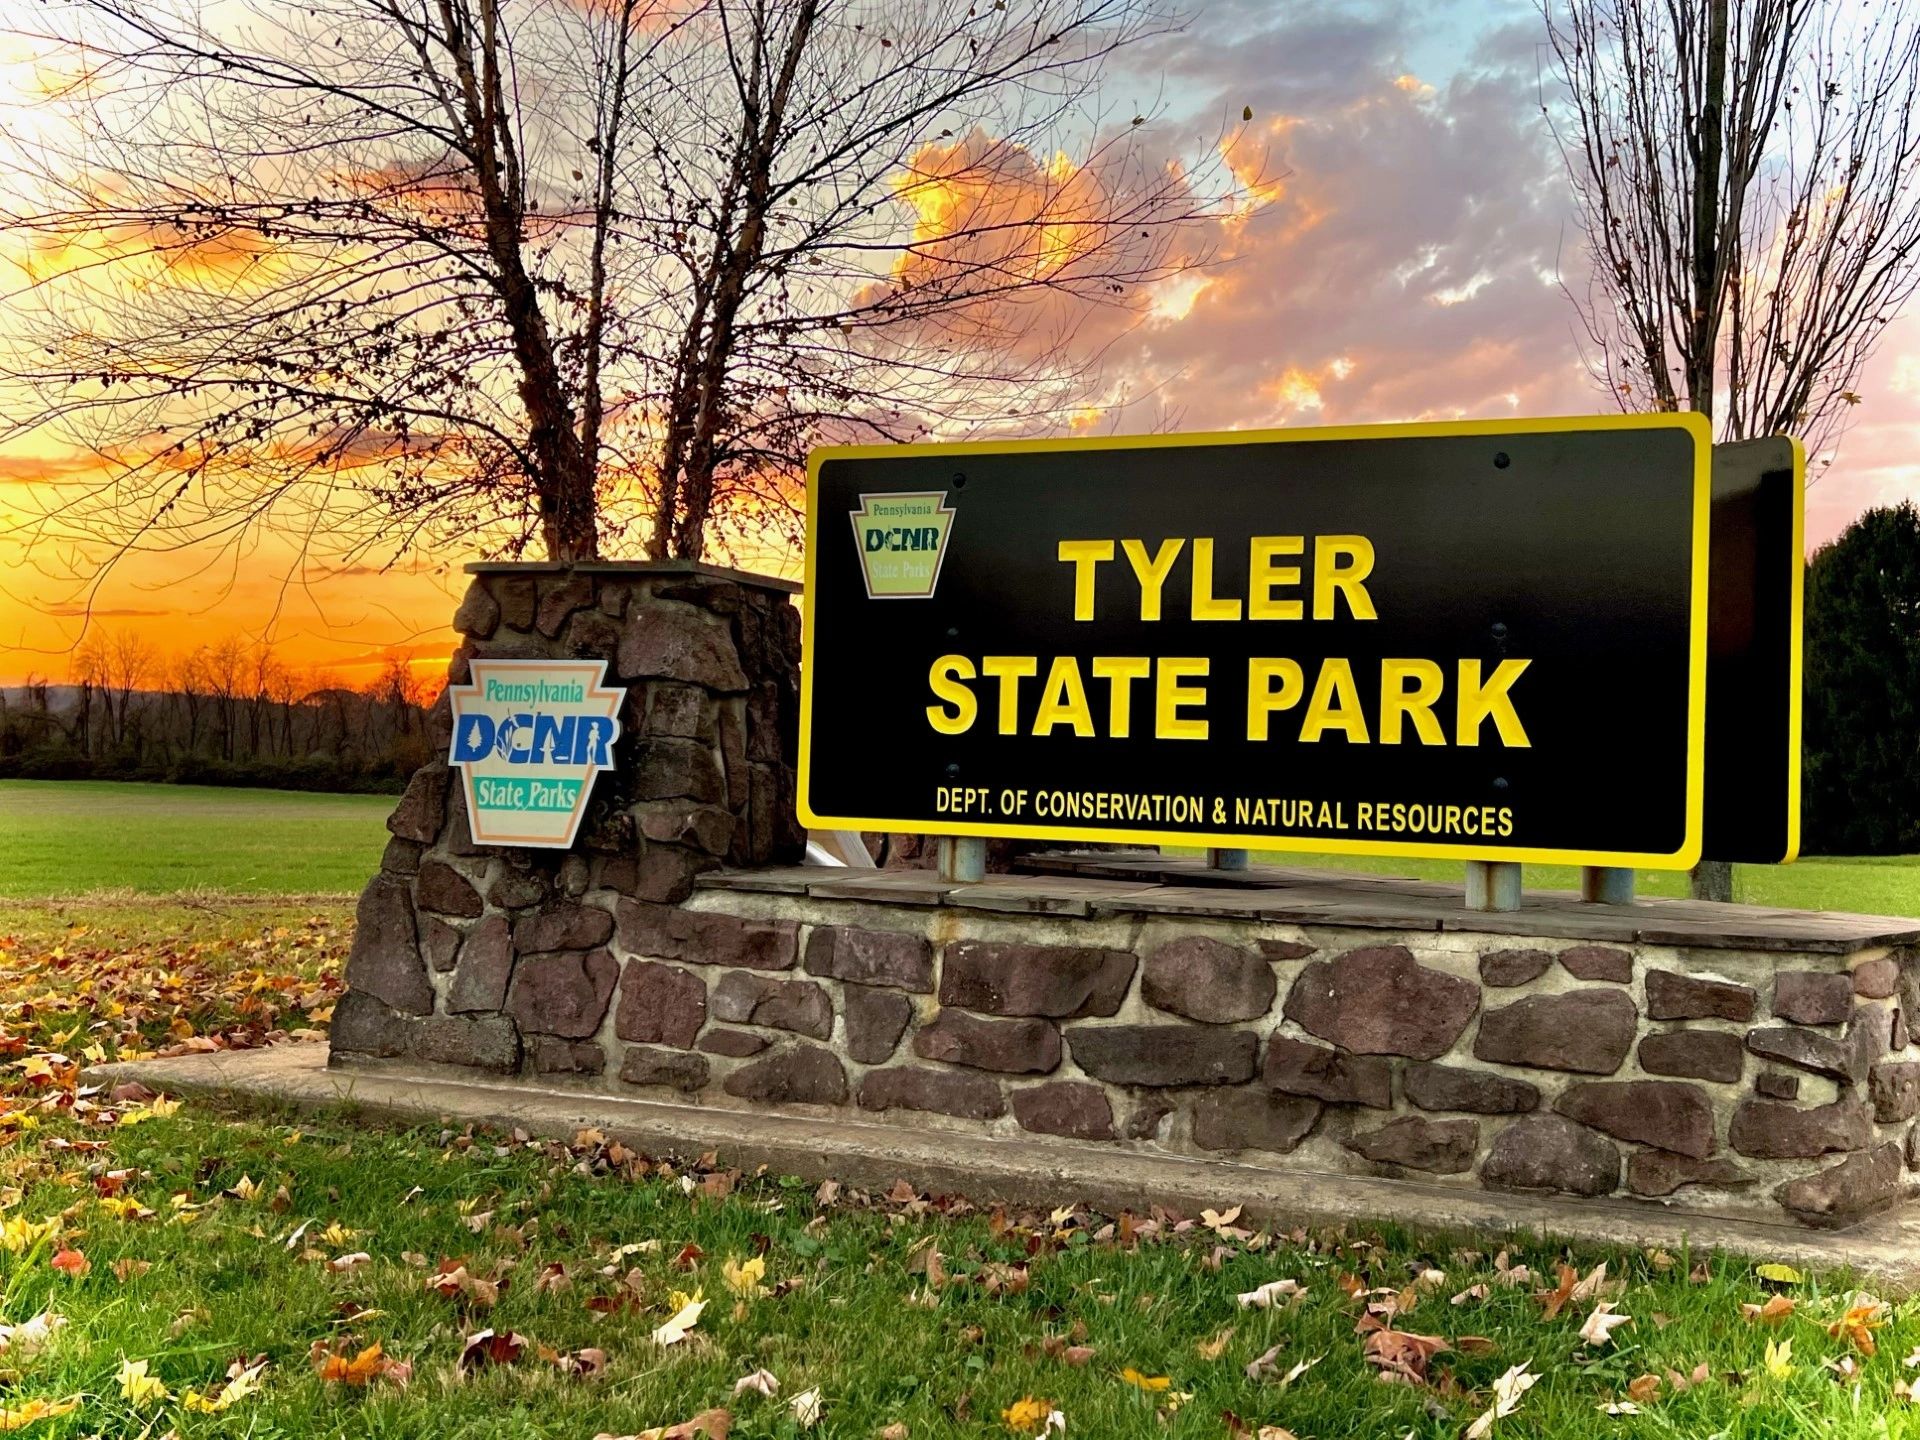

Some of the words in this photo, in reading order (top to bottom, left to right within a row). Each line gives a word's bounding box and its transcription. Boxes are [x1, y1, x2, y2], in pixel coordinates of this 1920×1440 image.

[873, 502, 932, 517] Pennsylvania
[865, 527, 939, 552] DCNR
[873, 560, 898, 578] State
[903, 560, 930, 578] Parks
[1058, 535, 1378, 621] TYLER
[486, 679, 583, 708] Pennsylvania
[926, 655, 1209, 740] STATE
[1247, 658, 1532, 747] PARK
[454, 713, 614, 765] DCNR
[478, 780, 523, 807] State
[528, 782, 577, 809] Parks
[936, 786, 992, 814] DEPT.
[1000, 789, 1028, 816] OF
[1035, 790, 1204, 824] CONSERVATION
[1211, 797, 1227, 825] &
[1235, 797, 1349, 829] NATURAL
[1357, 802, 1513, 837] RESOURCES
